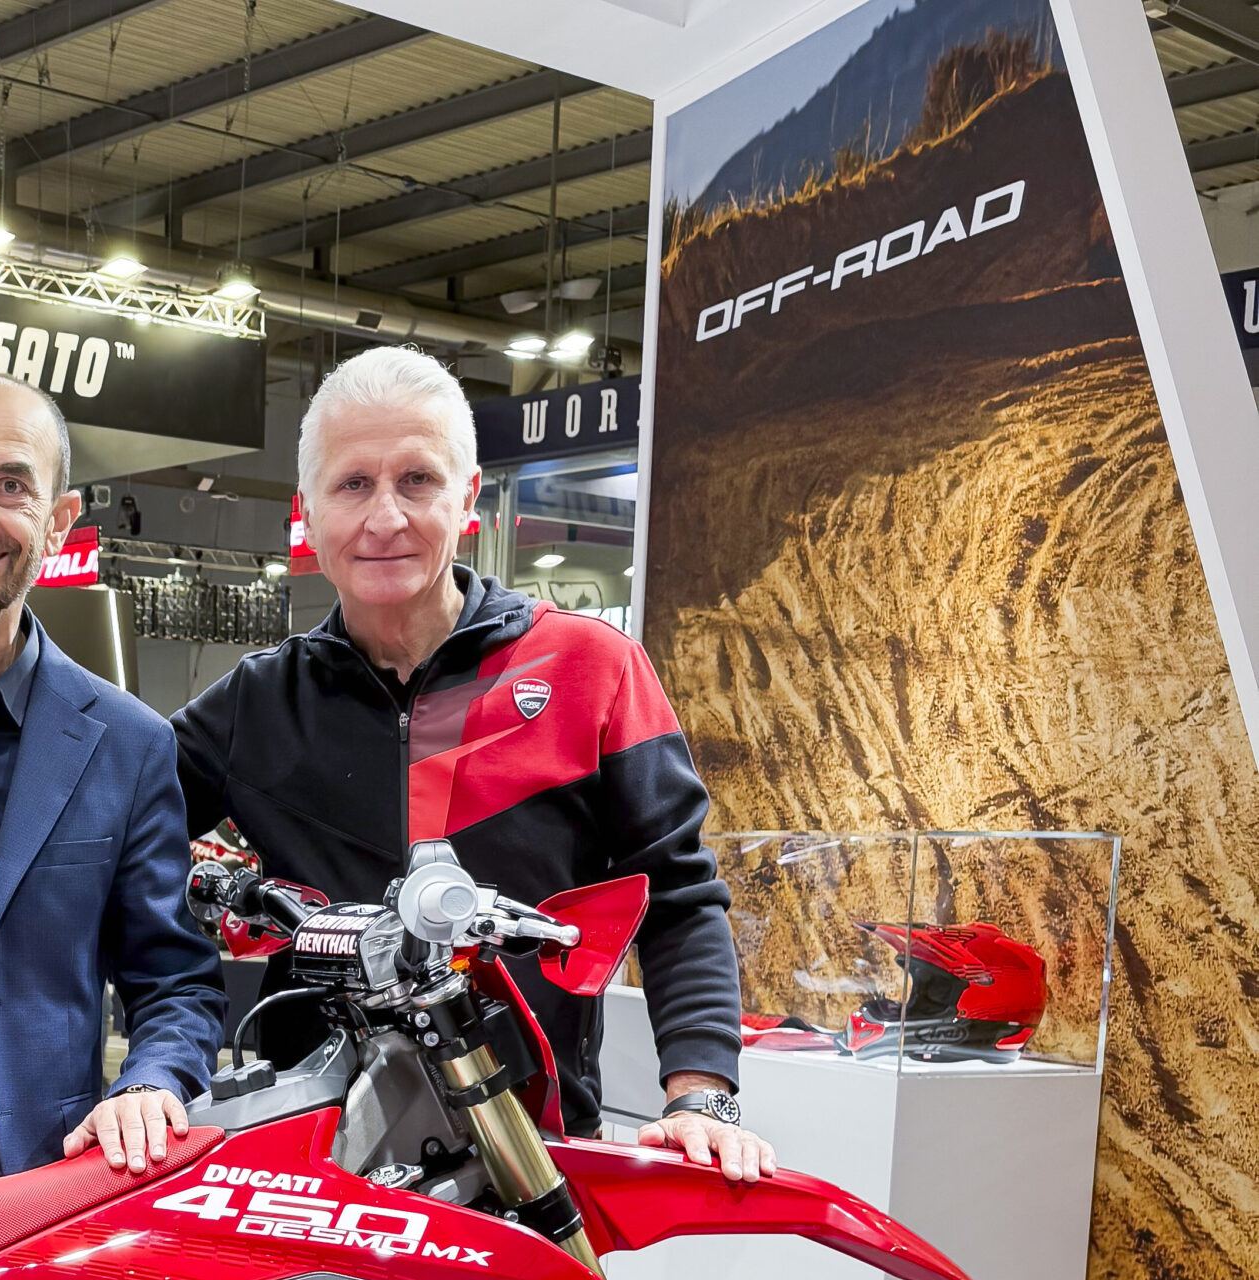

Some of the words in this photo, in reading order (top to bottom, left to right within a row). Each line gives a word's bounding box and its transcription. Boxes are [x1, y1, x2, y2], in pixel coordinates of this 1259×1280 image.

[696, 180, 1026, 342] OFF-ROAD
[522, 386, 642, 445] WOR
[40, 549, 99, 579] TALJ
[517, 683, 549, 694] DUCATI
[302, 914, 377, 931] RENTHAL
[295, 932, 358, 955] RENTHAL
[202, 1164, 322, 1194] DUCATI
[152, 1185, 430, 1239] 450
[235, 1217, 419, 1255] DESMO
[421, 1243, 493, 1266] MX
